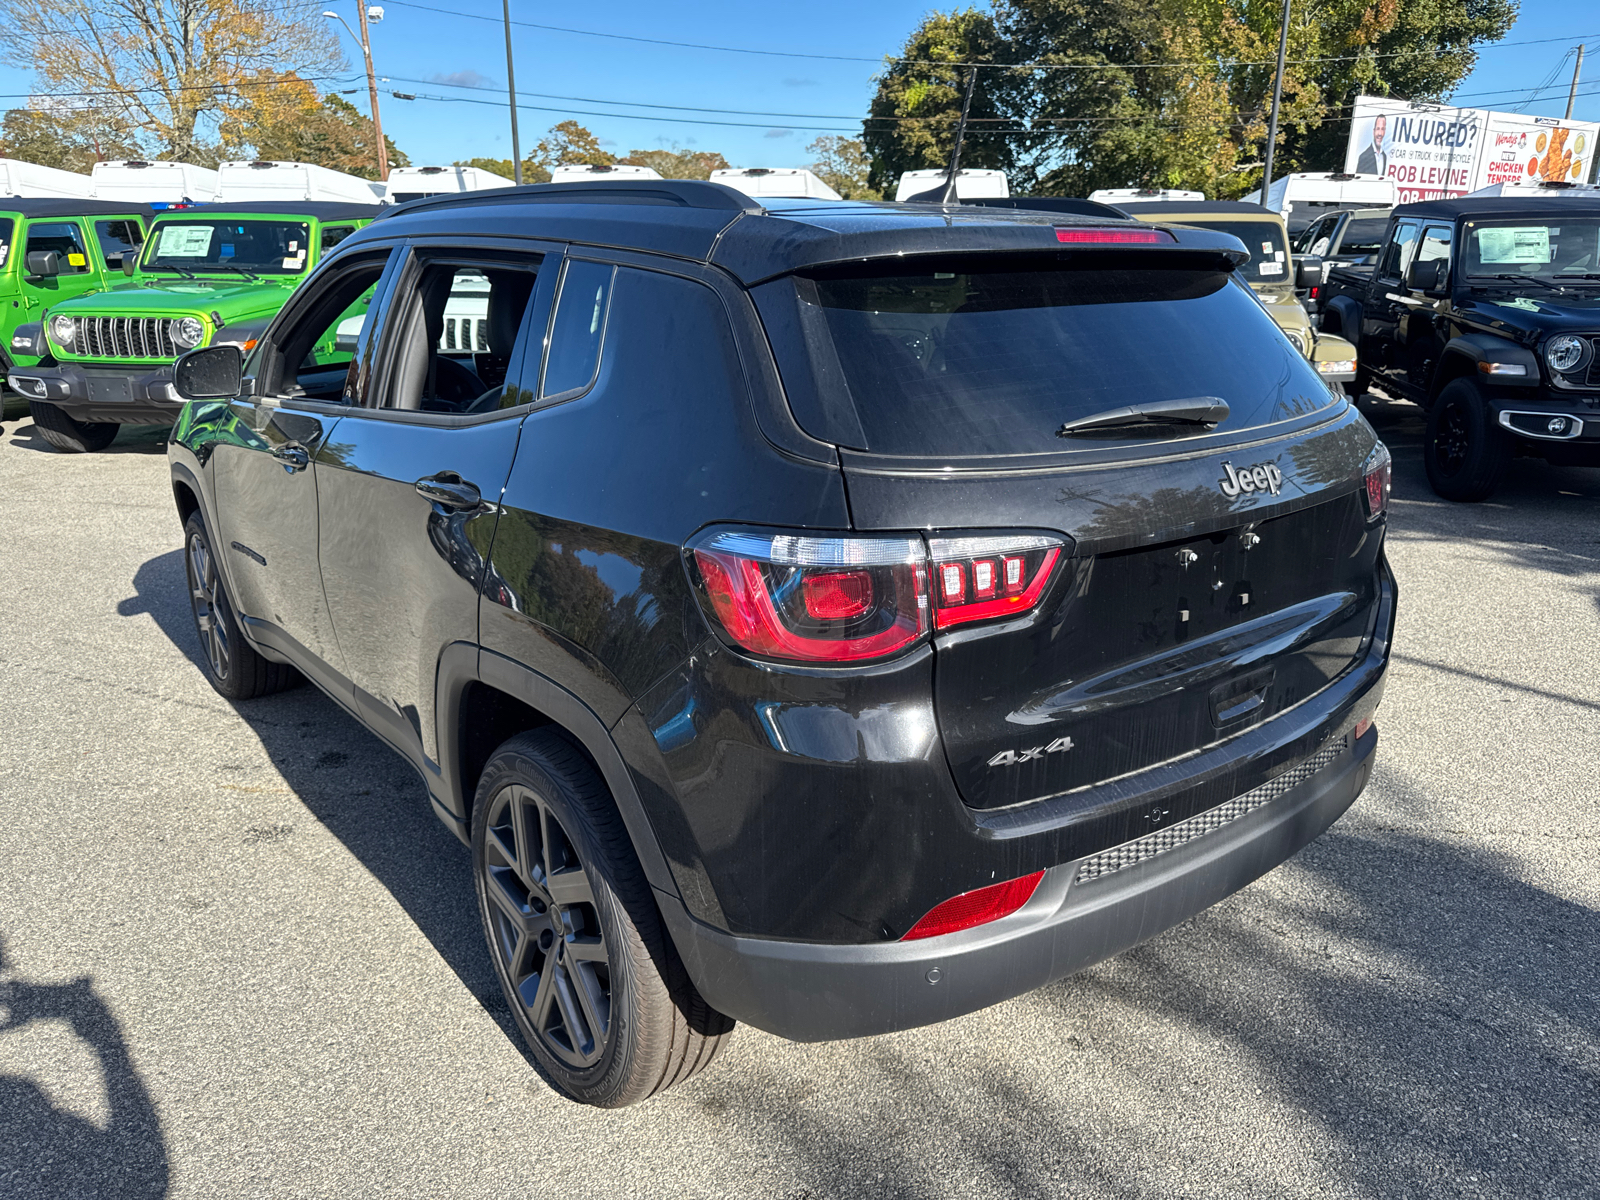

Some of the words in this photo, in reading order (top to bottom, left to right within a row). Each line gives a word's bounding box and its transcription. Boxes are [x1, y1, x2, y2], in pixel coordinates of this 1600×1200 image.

[1392, 116, 1477, 149] INJURED?
[1395, 149, 1406, 159] CAR
[1415, 151, 1432, 161] TRUCK
[1489, 161, 1524, 174] CHICKEN
[1501, 152, 1515, 160] NEW
[1387, 164, 1417, 183] ROB
[1419, 166, 1469, 186] LEVINE
[1218, 460, 1282, 498] Jeep
[986, 736, 1075, 768] 4x4
[515, 758, 554, 795] Continental
